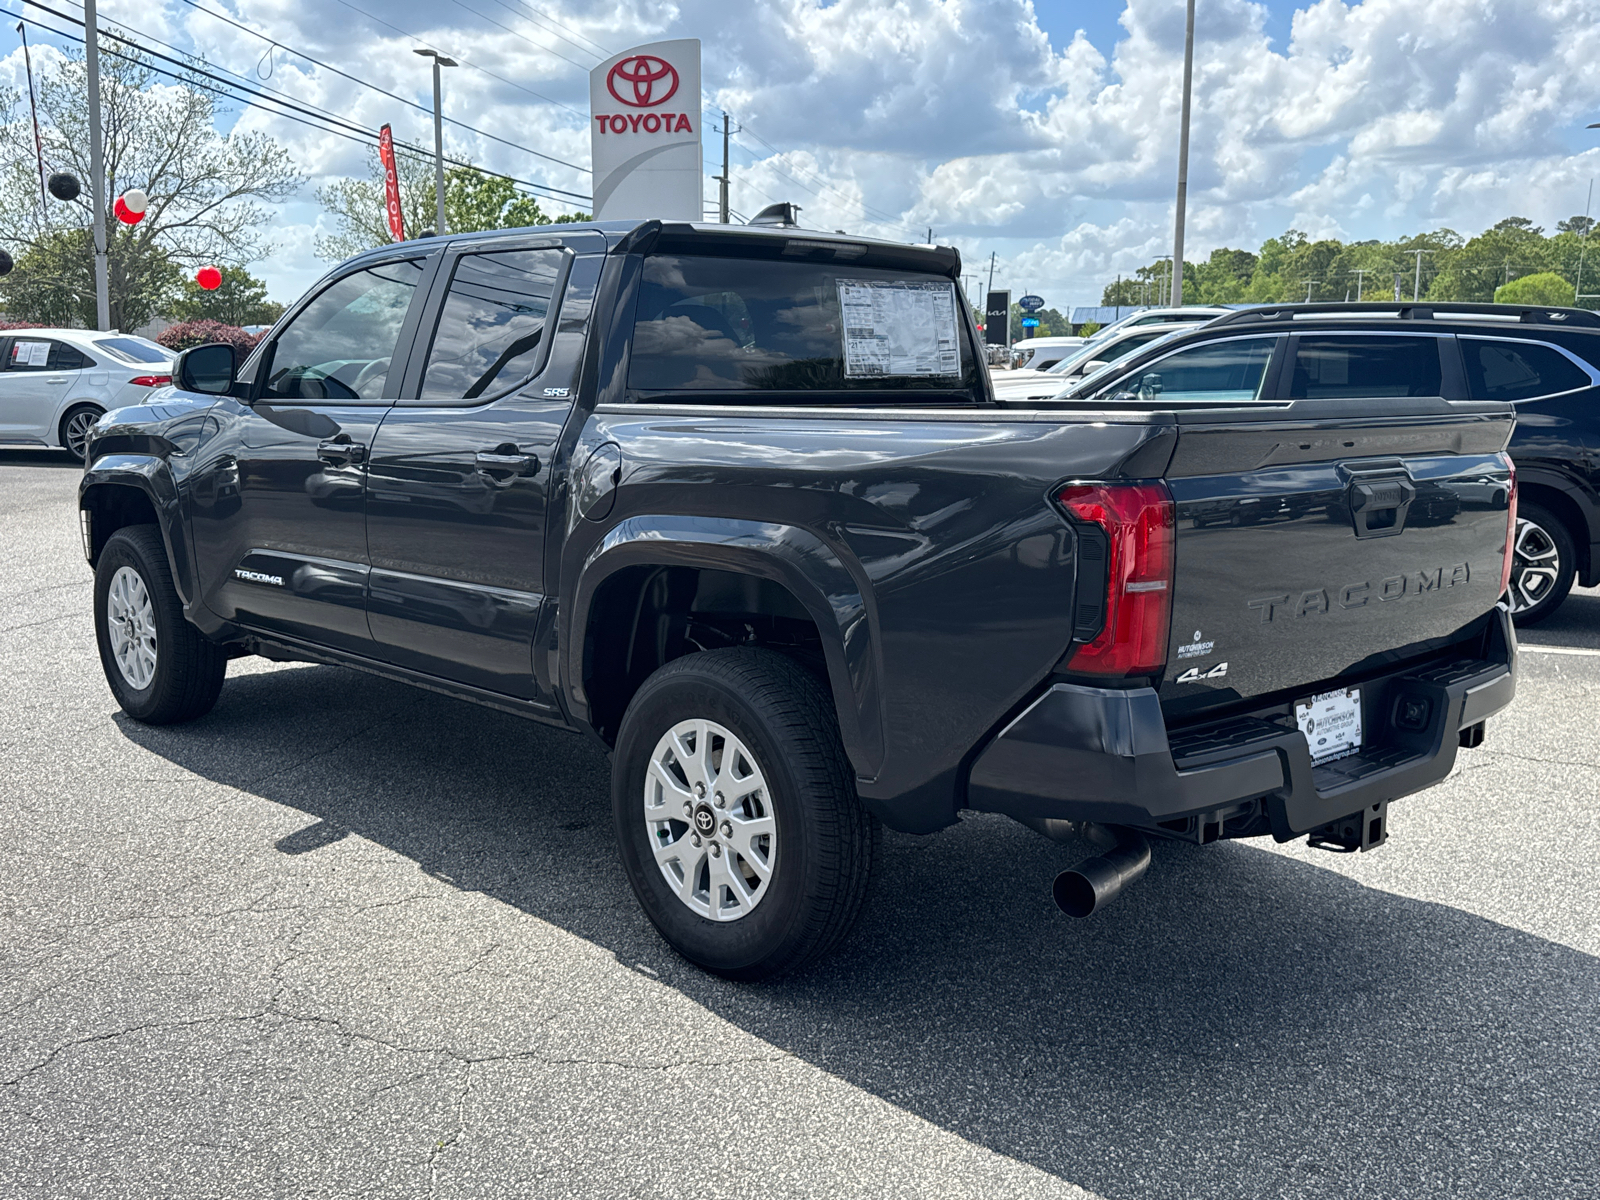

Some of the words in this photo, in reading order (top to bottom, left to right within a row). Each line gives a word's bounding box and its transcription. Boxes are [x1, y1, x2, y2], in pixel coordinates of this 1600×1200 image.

[595, 113, 693, 134] TOYOTA
[234, 569, 286, 586] TACOMA
[1248, 561, 1470, 624] TACOMA
[1178, 641, 1215, 653] HUTCHINSON
[1315, 711, 1355, 729] HUTCHINSON
[1316, 724, 1340, 736] AUTOMOTIVE
[1341, 719, 1354, 729] GROUP
